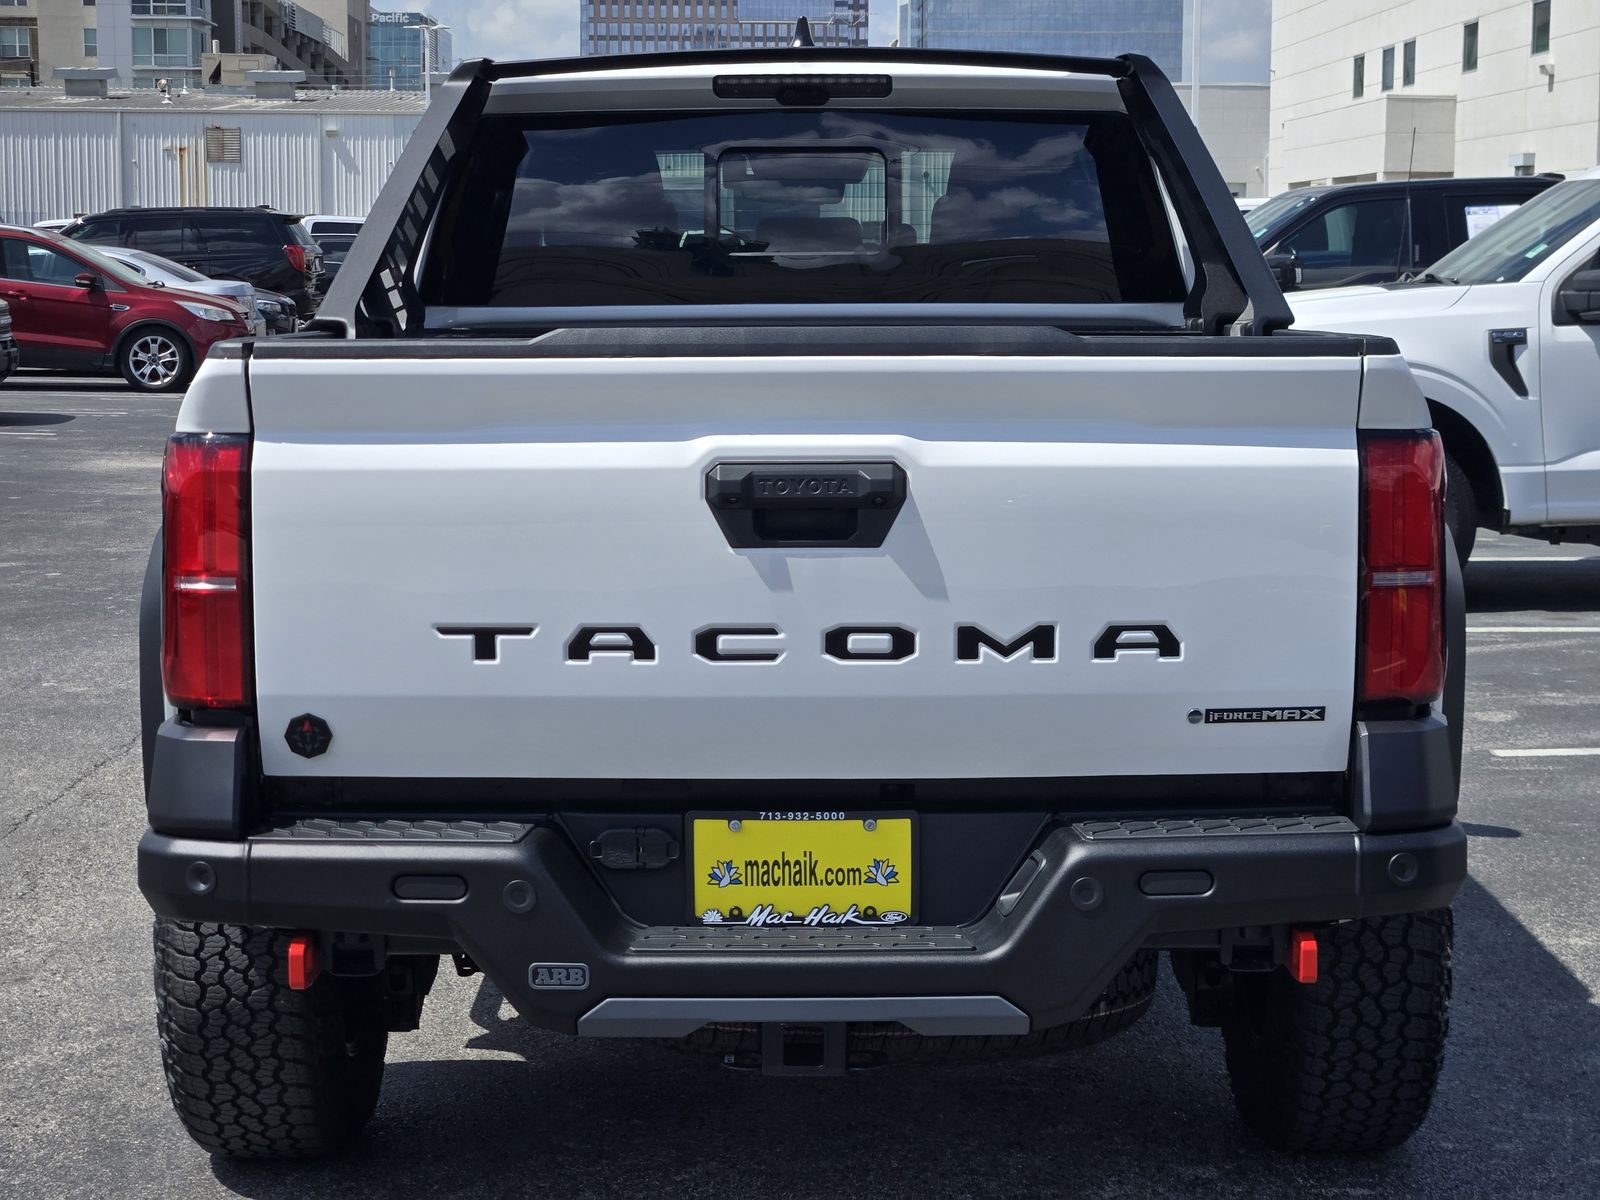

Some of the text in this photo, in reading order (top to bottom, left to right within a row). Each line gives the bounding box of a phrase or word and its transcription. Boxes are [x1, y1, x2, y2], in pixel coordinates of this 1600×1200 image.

[371, 12, 410, 23] Pacific
[758, 478, 854, 495] TOYOTA
[433, 622, 1185, 665] TACOMA
[759, 811, 846, 821] 713-932-5000
[744, 850, 862, 887] machaik.com
[747, 903, 861, 926] Mac Haik
[535, 968, 584, 985] ARB
